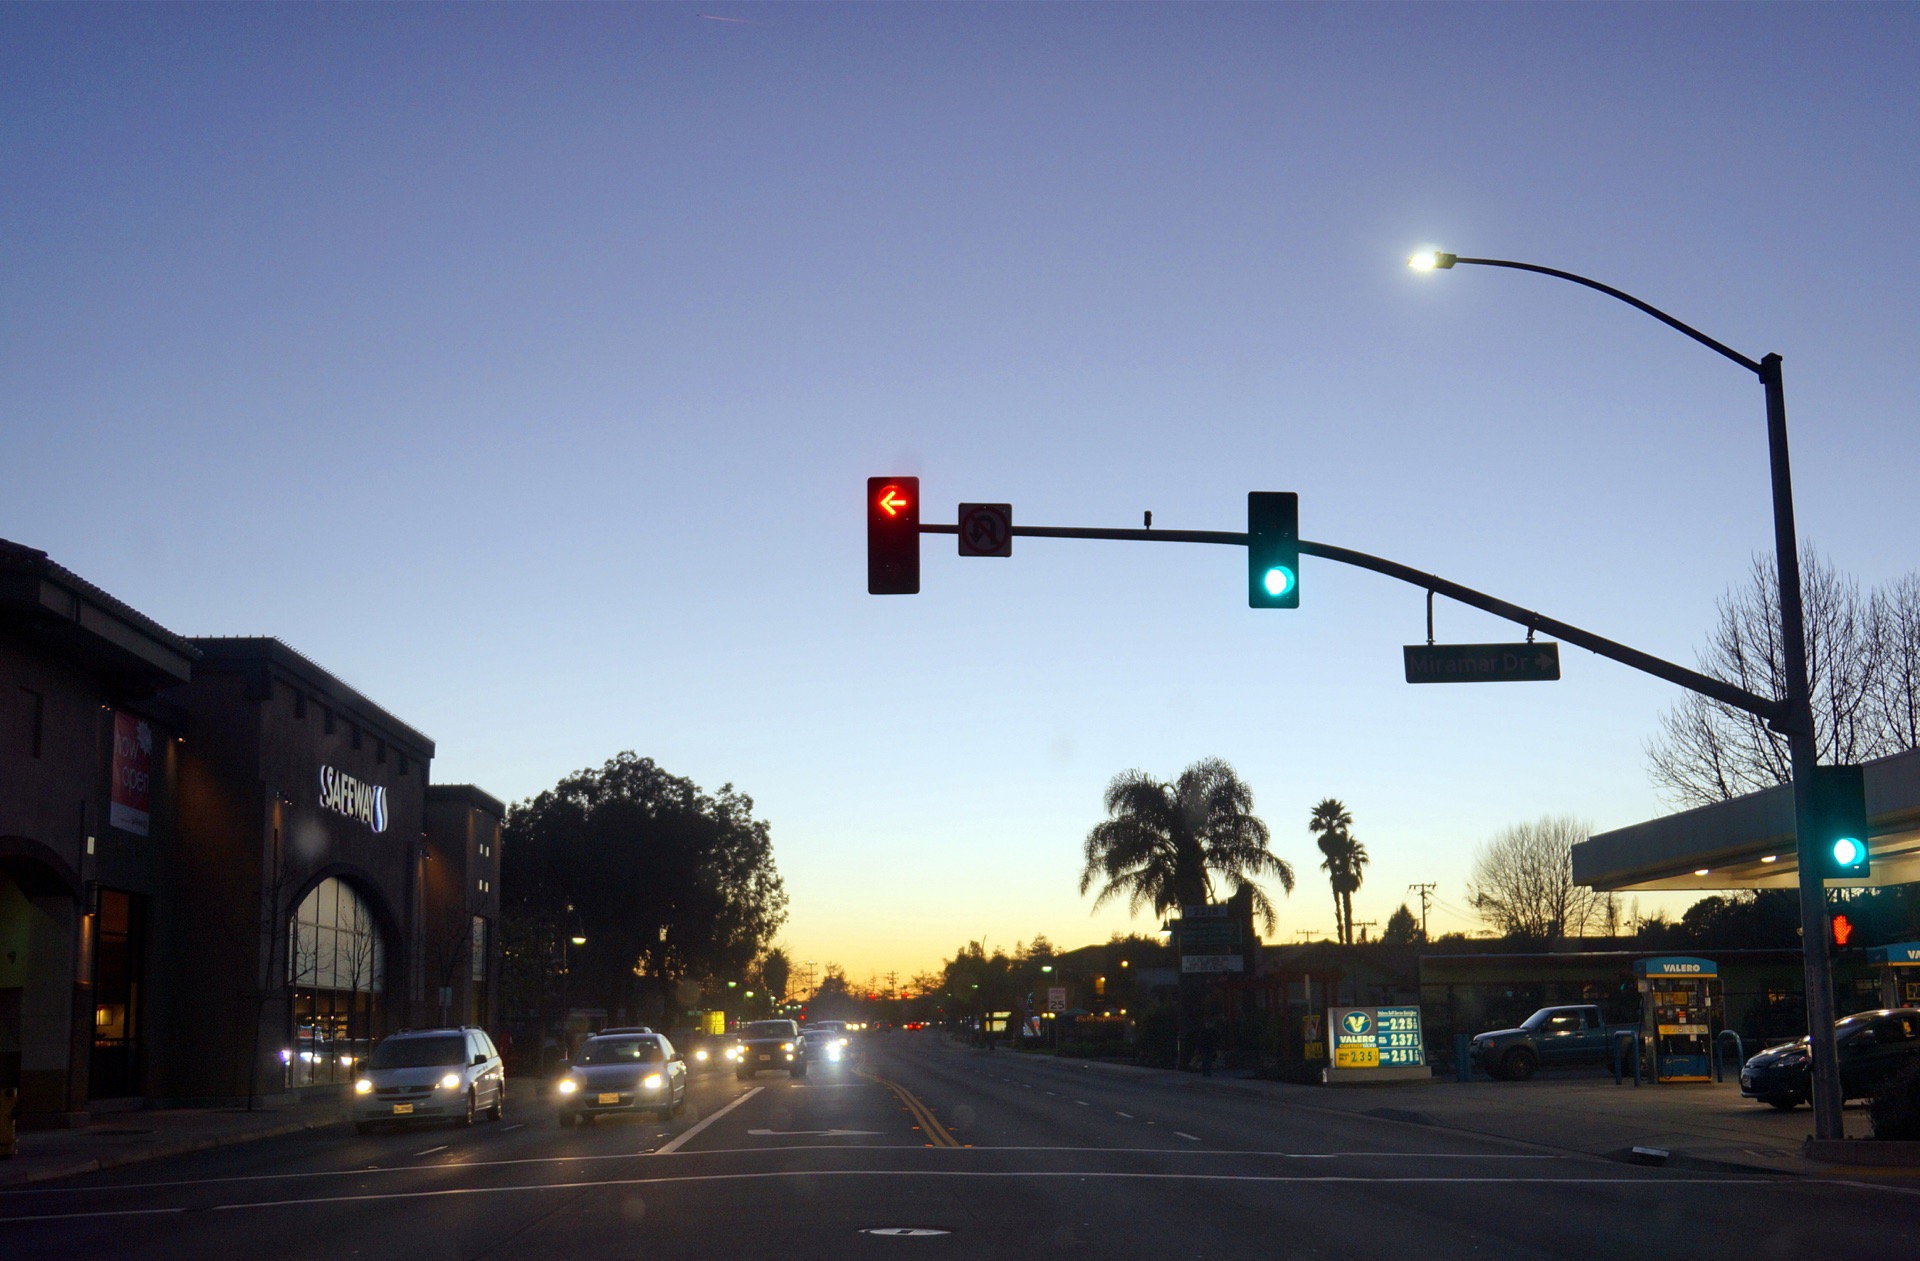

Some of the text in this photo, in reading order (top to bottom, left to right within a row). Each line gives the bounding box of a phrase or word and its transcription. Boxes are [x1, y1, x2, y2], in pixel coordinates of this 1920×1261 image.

[1409, 652, 1529, 673] Miramar Dr
[114, 734, 139, 761] now
[123, 766, 150, 798] open
[320, 766, 377, 824] SAFEWAY
[1663, 964, 1701, 972] VALERO
[1050, 1000, 1065, 1010] 25
[1340, 1035, 1376, 1043] VALERO
